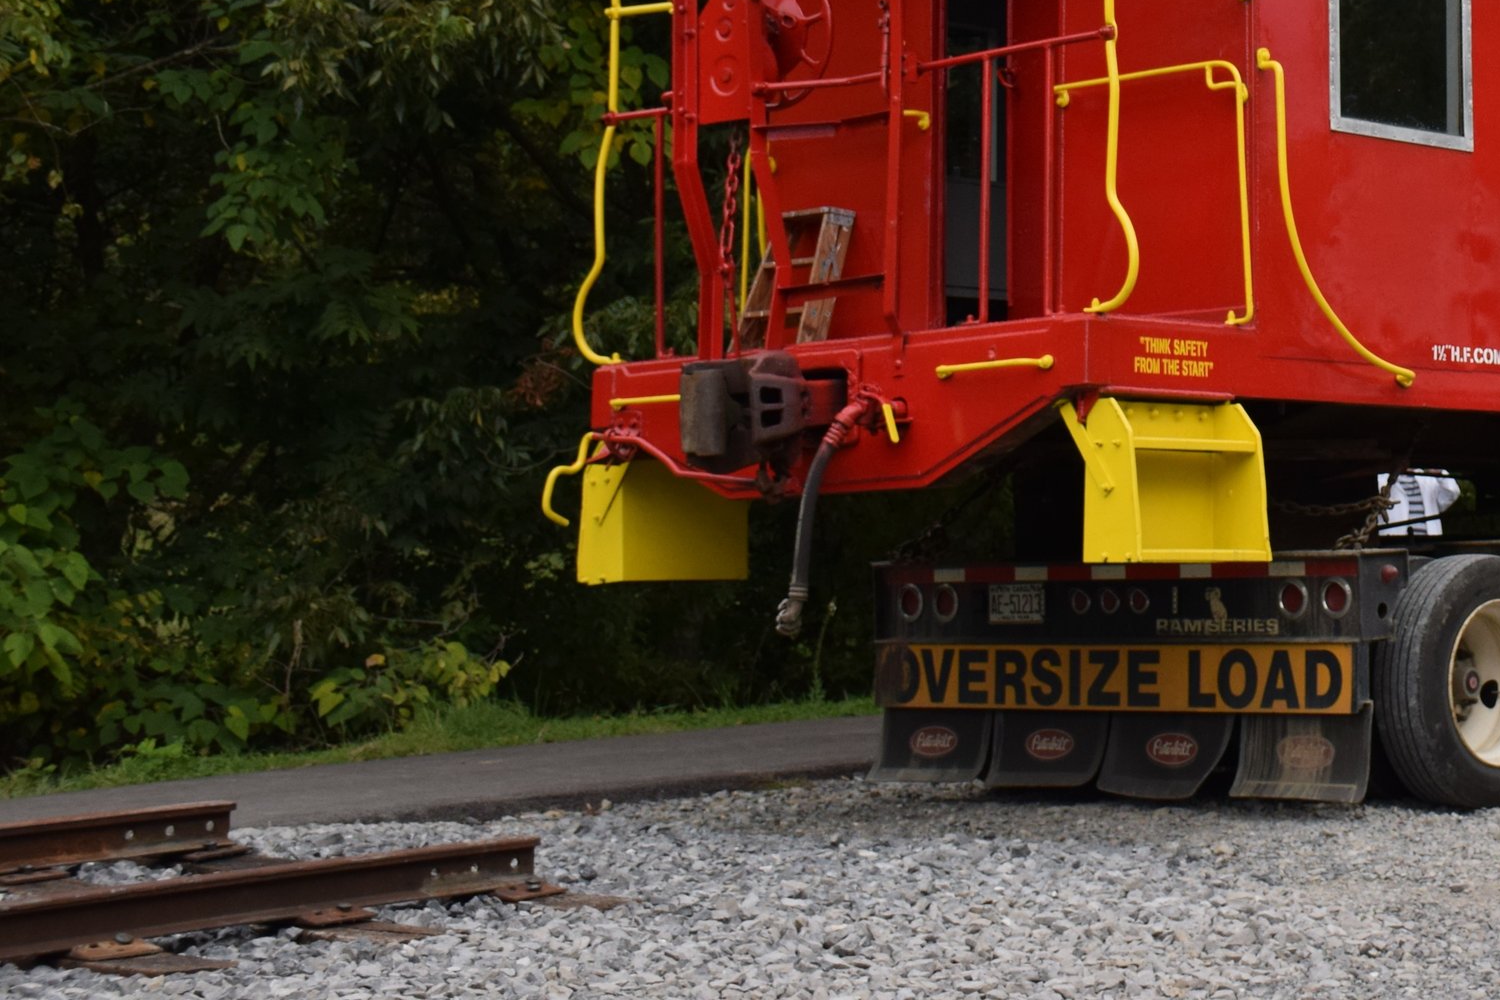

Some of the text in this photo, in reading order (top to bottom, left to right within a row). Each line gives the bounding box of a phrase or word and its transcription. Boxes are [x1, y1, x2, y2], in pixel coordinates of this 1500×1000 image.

[1173, 339, 1208, 357] SAFETY
[1134, 356, 1161, 374] FROM
[1161, 359, 1181, 376] THE
[1156, 618, 1202, 633] RAM
[1188, 648, 1343, 710] LOAD
